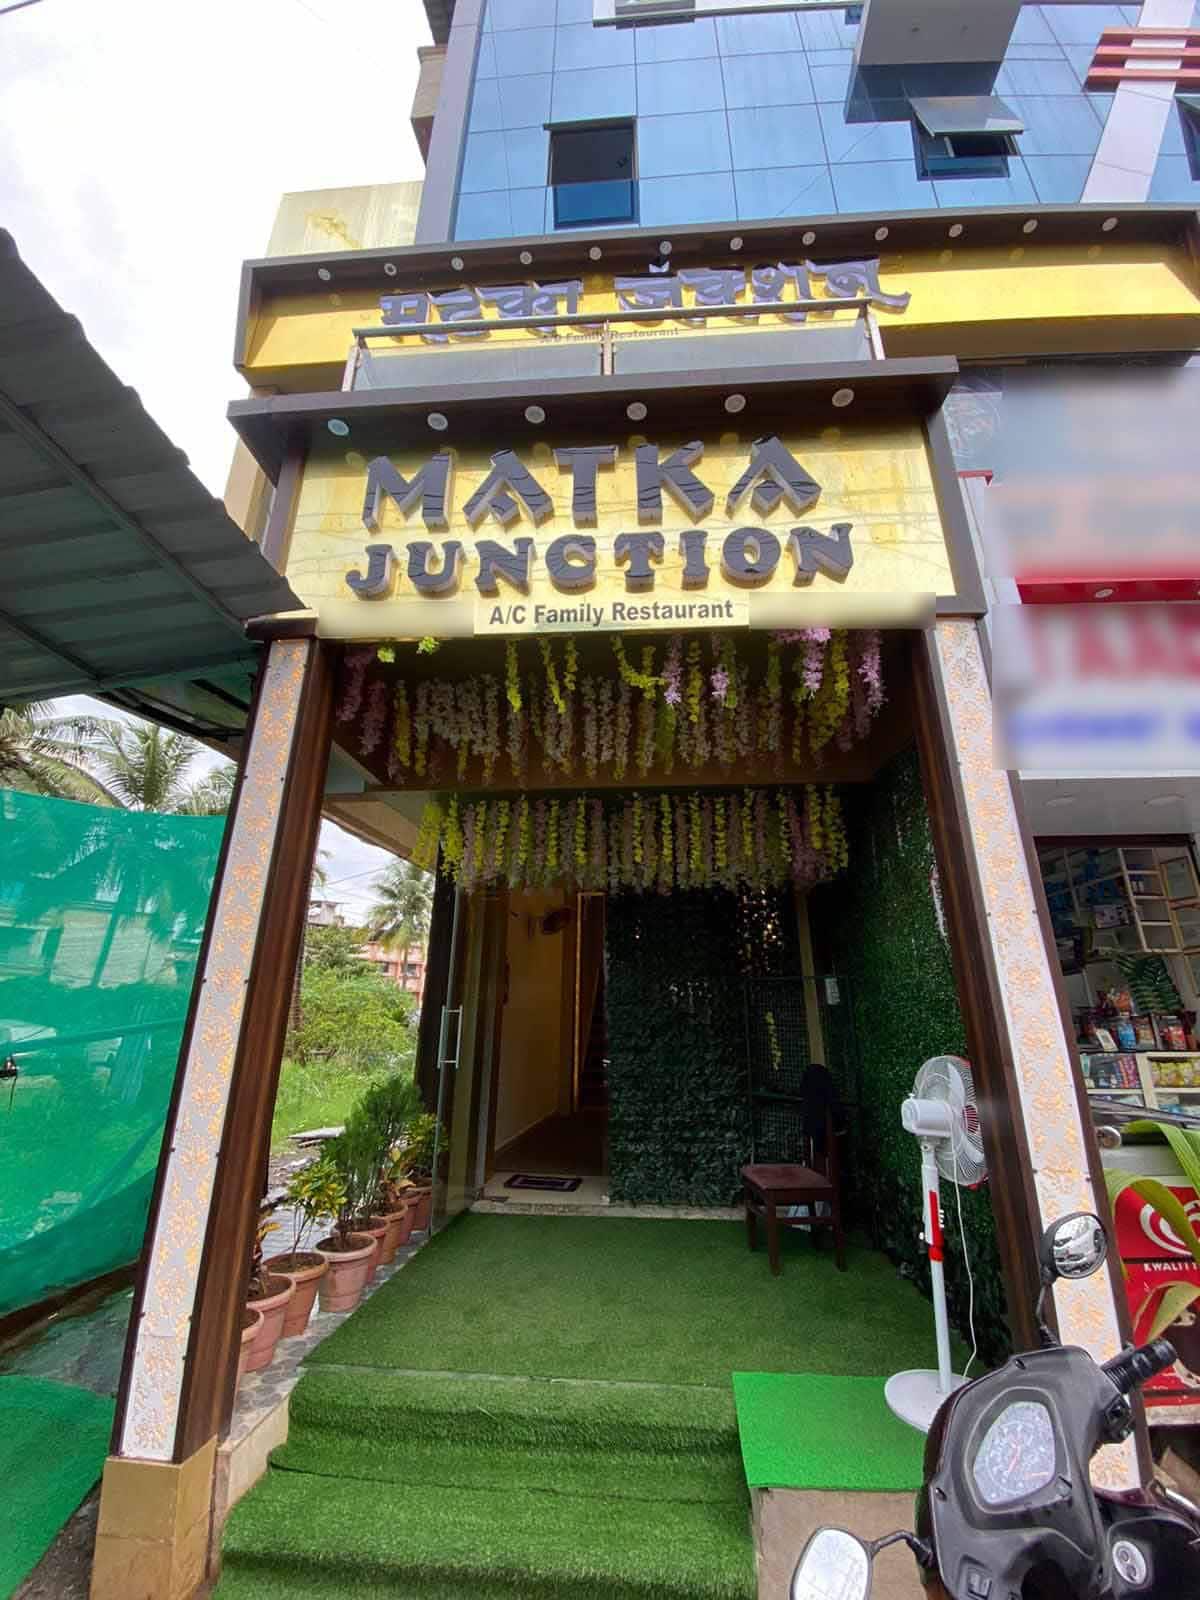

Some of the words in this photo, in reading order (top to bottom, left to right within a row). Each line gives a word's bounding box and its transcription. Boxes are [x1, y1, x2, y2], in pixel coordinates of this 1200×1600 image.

[361, 434, 824, 534] MATKA
[345, 522, 855, 599] JUNCTION
[489, 606, 527, 625] A/C
[533, 603, 604, 627] Family
[612, 599, 734, 622] Restaurant
